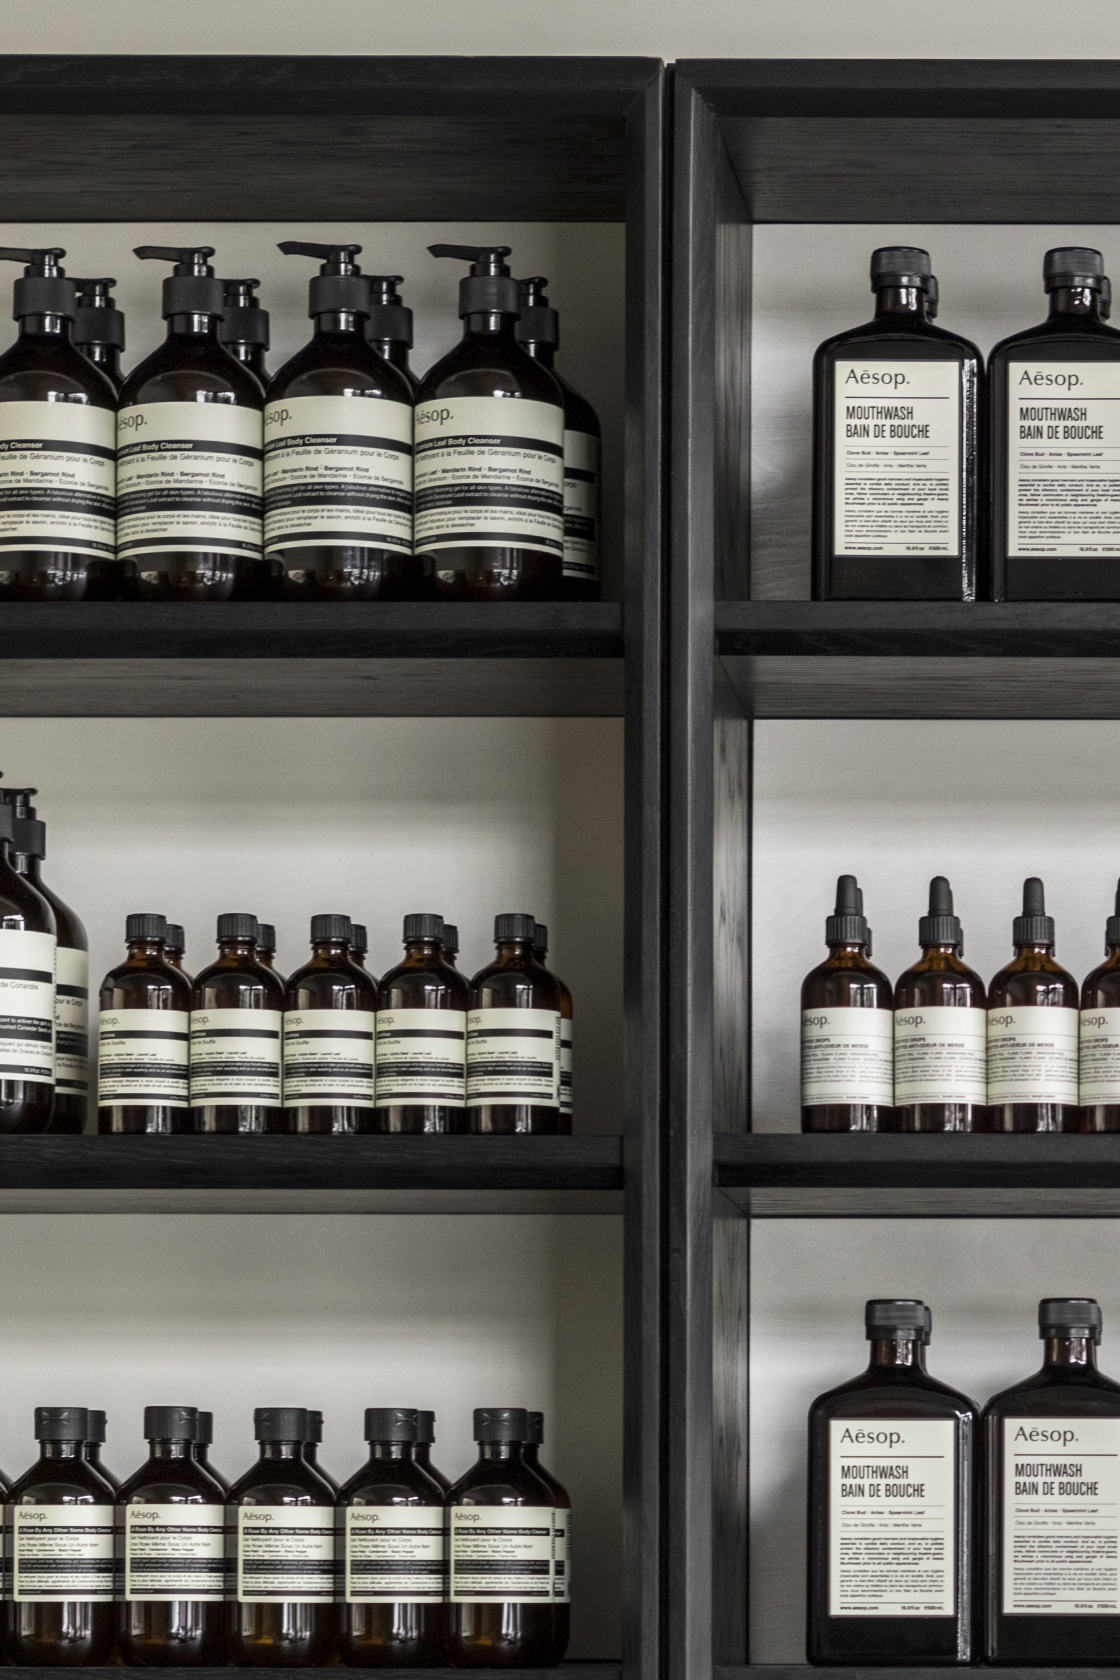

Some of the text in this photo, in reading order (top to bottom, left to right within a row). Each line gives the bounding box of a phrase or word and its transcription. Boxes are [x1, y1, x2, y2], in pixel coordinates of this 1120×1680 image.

[845, 368, 910, 390] Aēsop.
[1019, 369, 1084, 391] Aēsop.
[846, 406, 914, 420] MOUTHWASH
[1020, 407, 1088, 421] MOUTHWASH
[846, 424, 930, 439] BAIN DE BOUCHE
[1020, 425, 1104, 440] BAIN DE BOUCHE
[10, 442, 43, 450] Cleanser
[447, 438, 467, 447] Body
[467, 437, 501, 445] Cleanser
[487, 449, 522, 458] Géranium
[523, 452, 538, 462] pour
[10, 981, 39, 991] Coriandre
[840, 1427, 905, 1449] Aēsop.
[1014, 1425, 1079, 1447] Aēsop.
[841, 1465, 909, 1479] MOUTHWASH
[1015, 1463, 1083, 1477] MOUTHWASH
[841, 1483, 925, 1498] BAIN DE BOUCHE
[1015, 1481, 1099, 1496] BAIN DE BOUCHE
